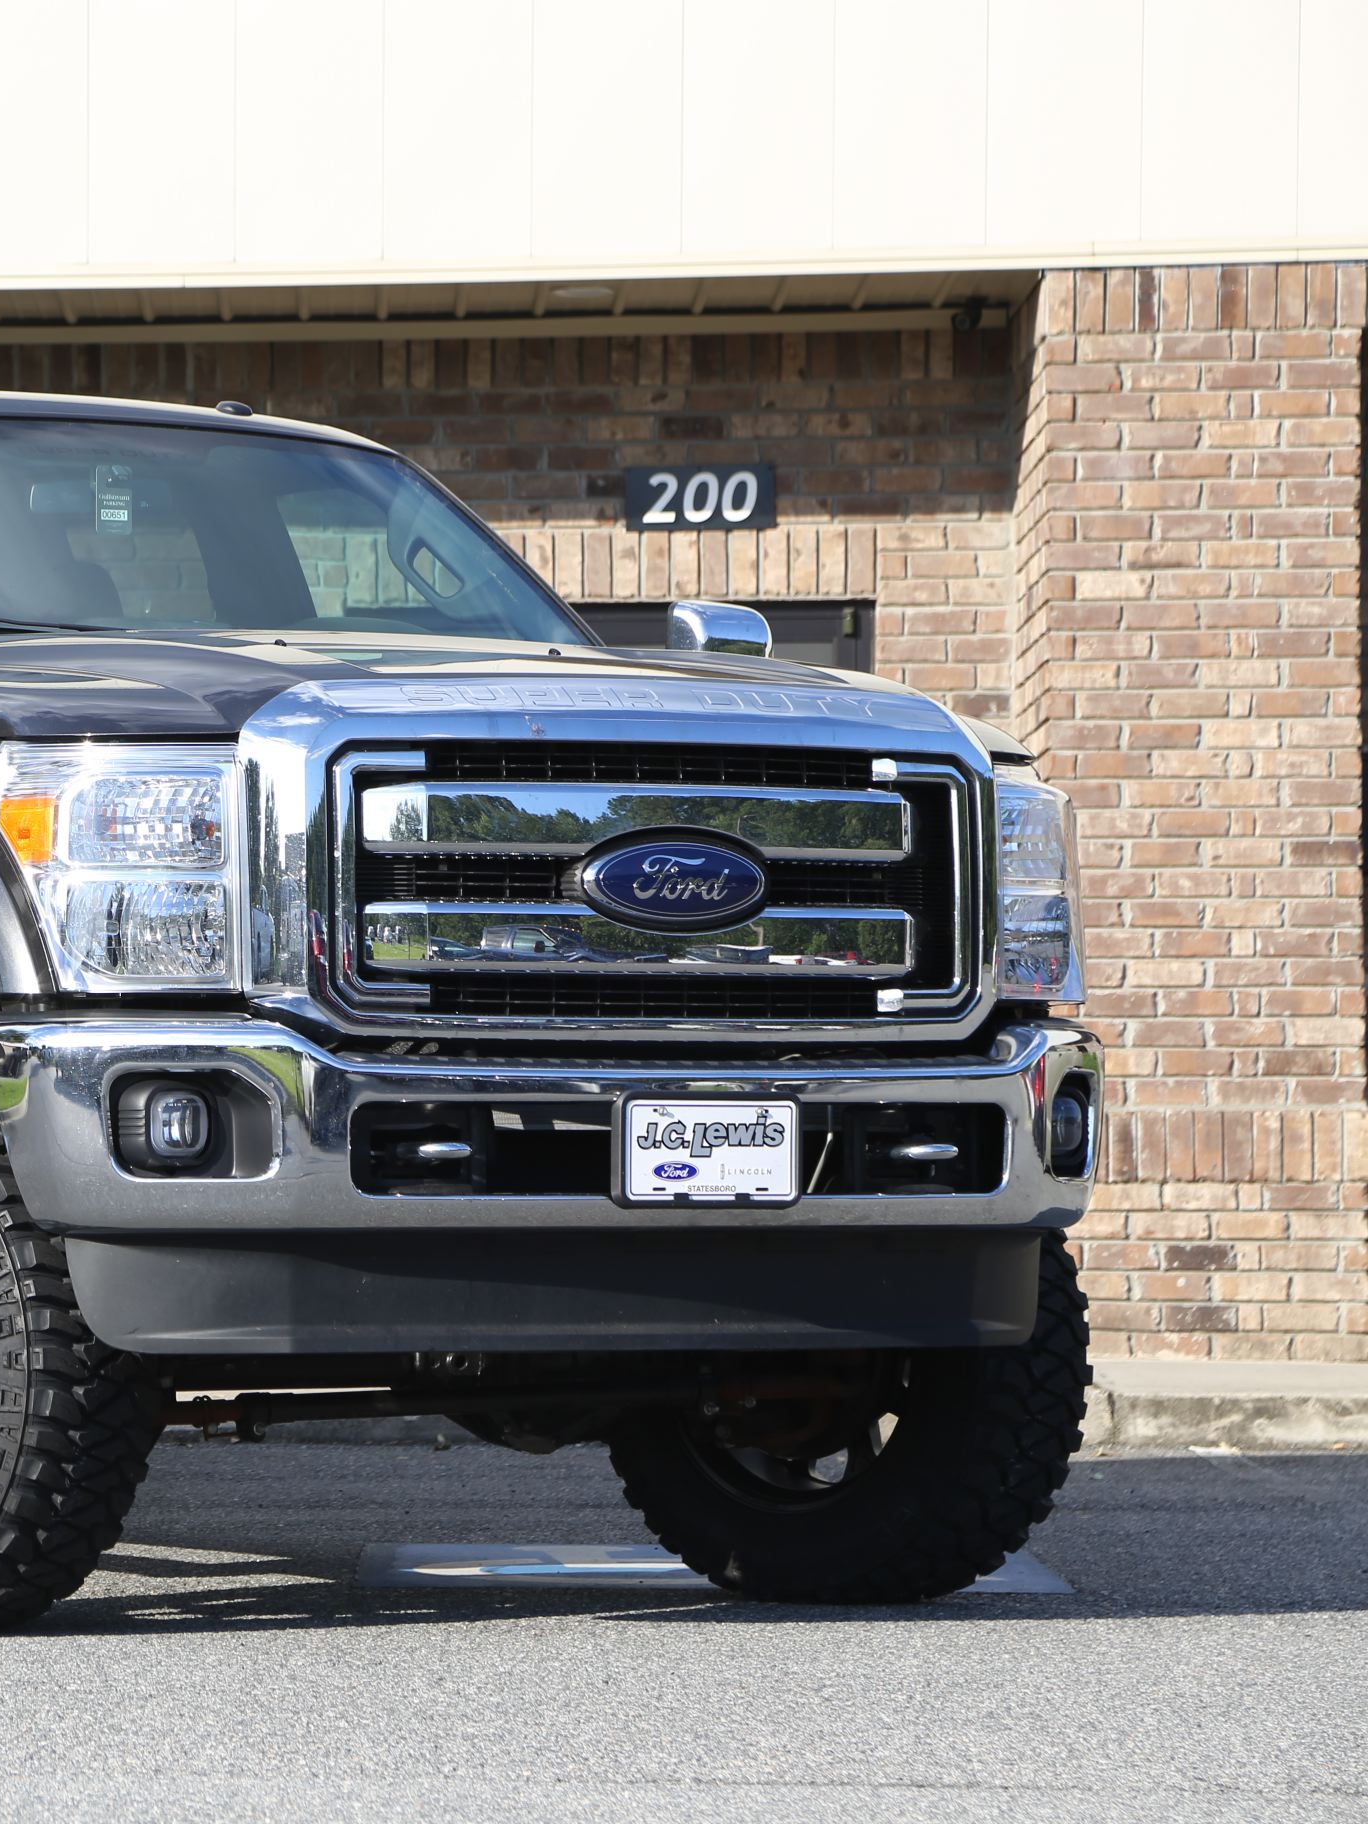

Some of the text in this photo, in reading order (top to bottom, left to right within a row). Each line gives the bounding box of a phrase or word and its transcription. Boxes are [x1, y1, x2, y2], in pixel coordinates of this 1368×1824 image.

[642, 471, 758, 524] 200
[102, 510, 126, 520] 00651
[400, 684, 875, 718] SUPER DUTY
[633, 854, 729, 901] Ford
[689, 1115, 785, 1158] Lewis
[660, 1162, 690, 1178] Ford
[727, 1168, 773, 1177] LINCOLN
[687, 1184, 737, 1193] STATESBORO
